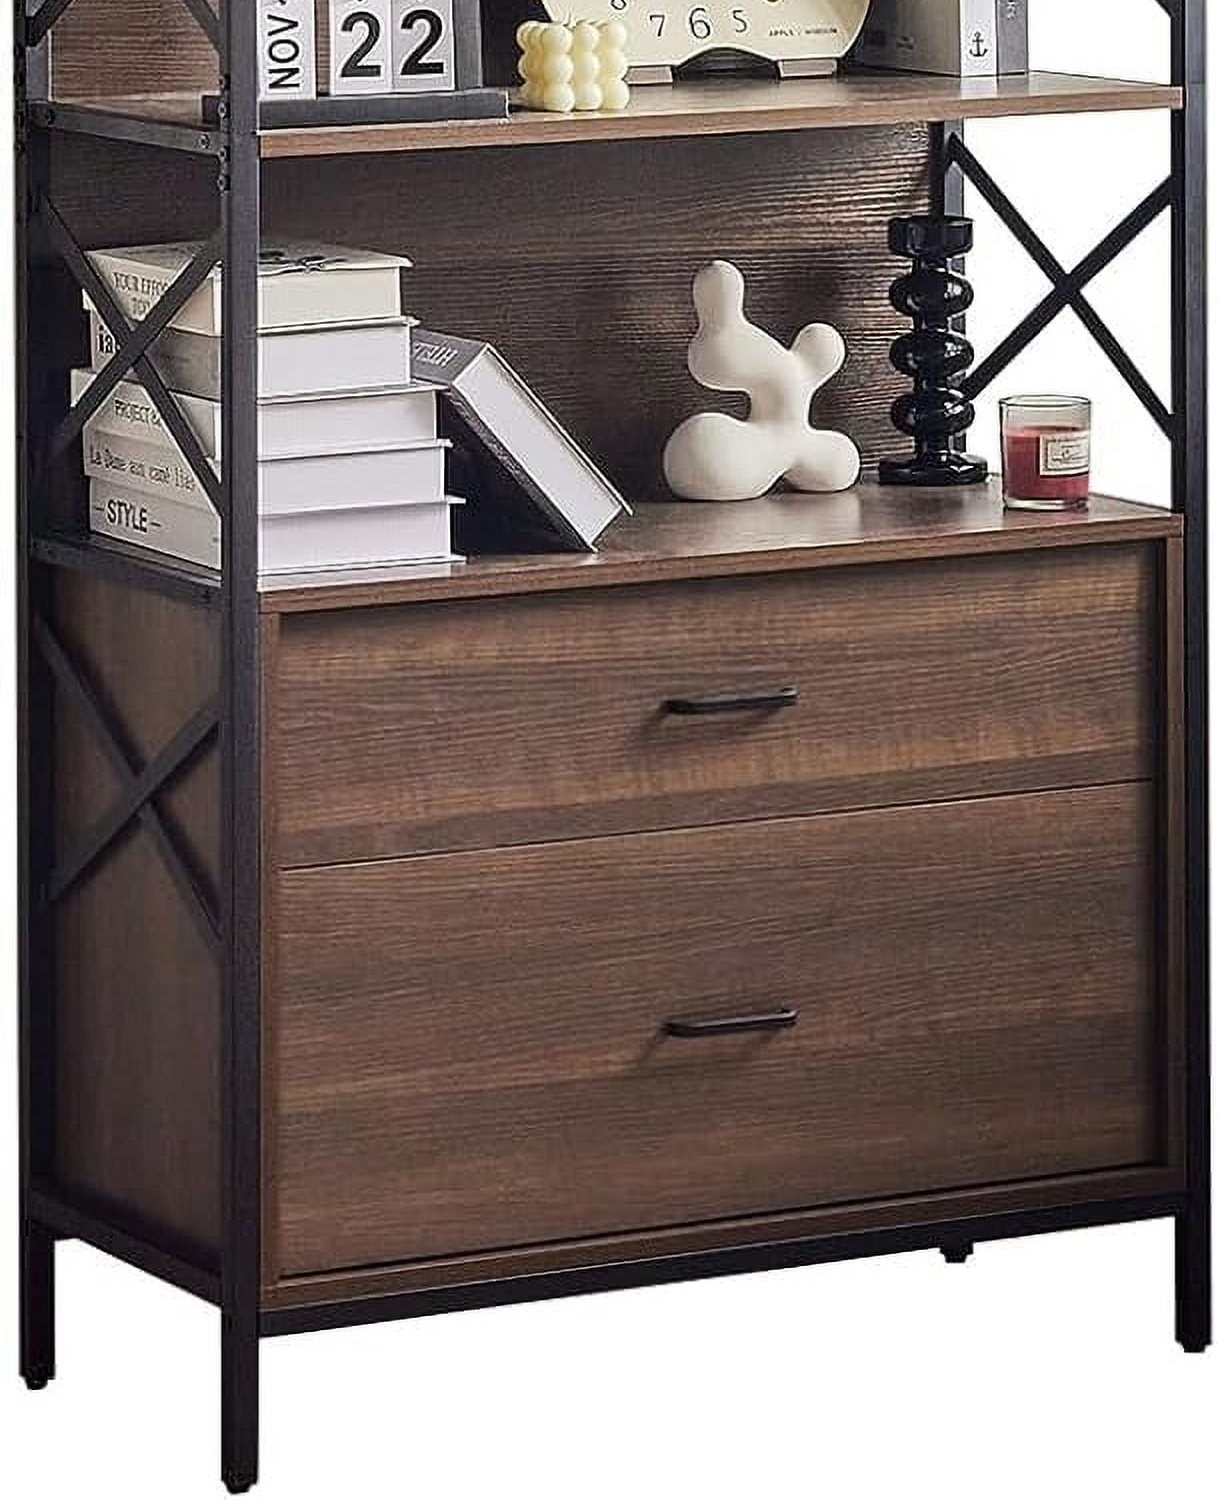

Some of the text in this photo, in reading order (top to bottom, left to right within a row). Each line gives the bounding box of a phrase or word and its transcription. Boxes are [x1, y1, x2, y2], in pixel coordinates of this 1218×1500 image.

[649, 7, 748, 40] 7 6 5
[267, 13, 300, 89] NOV
[107, 499, 148, 533] STYLE
